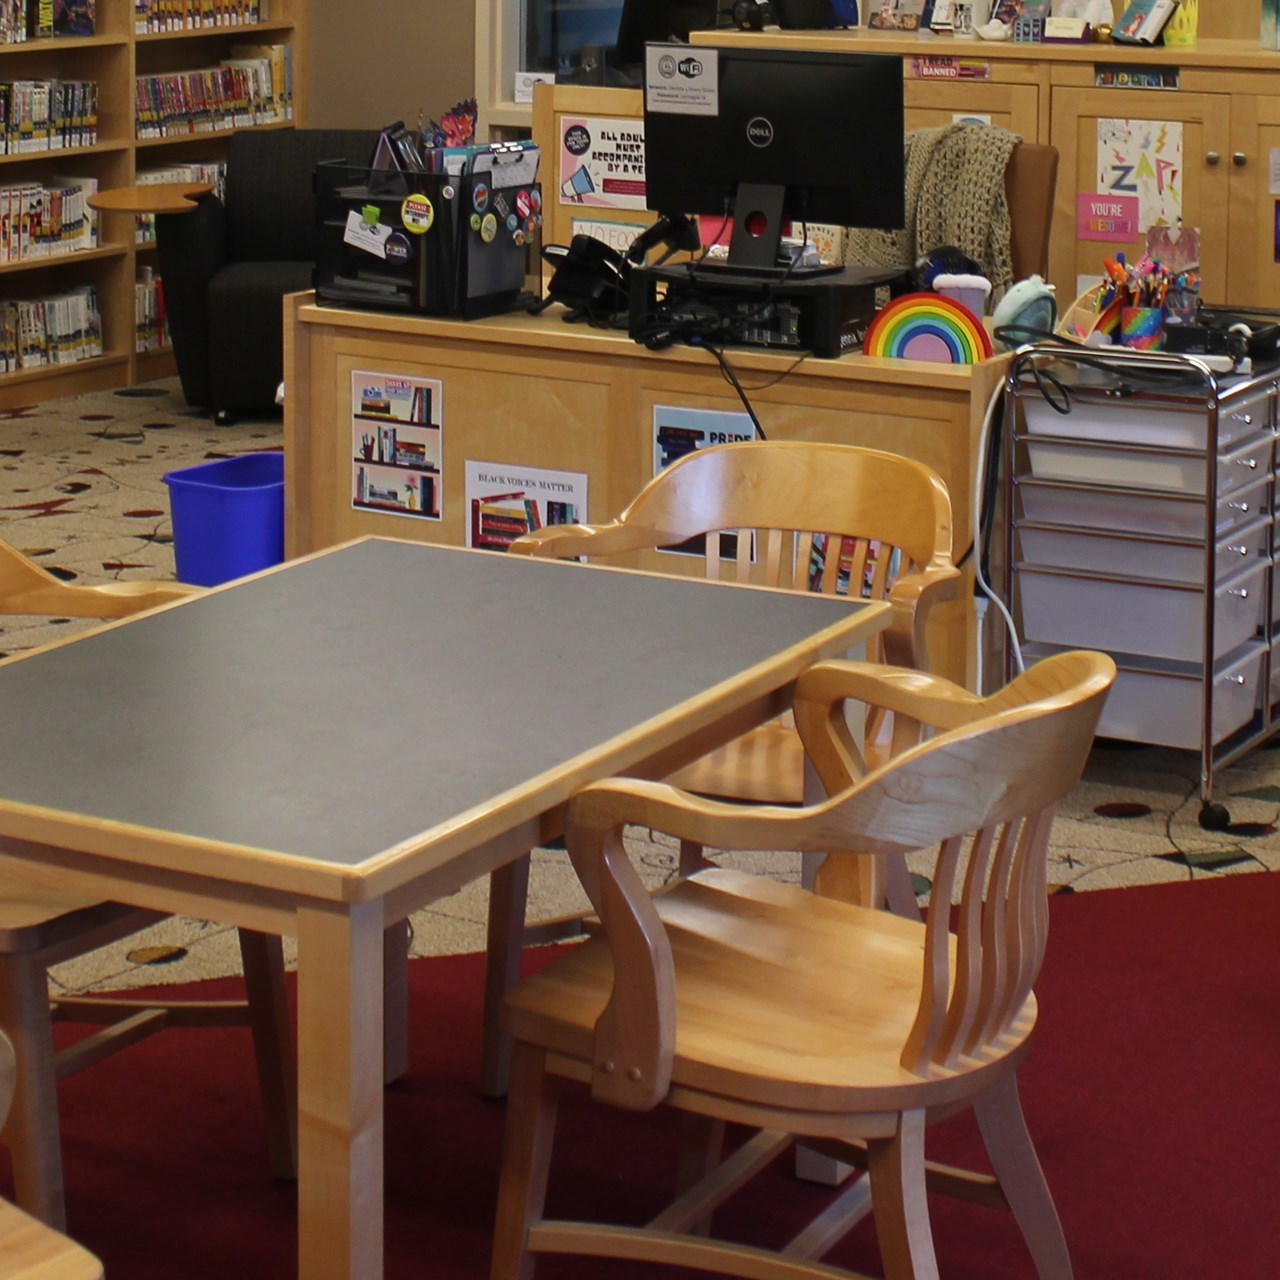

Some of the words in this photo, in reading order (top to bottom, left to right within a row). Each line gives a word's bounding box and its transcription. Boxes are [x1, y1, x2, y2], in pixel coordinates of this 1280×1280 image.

[929, 57, 954, 67] READ
[922, 67, 957, 77] BANNED
[601, 131, 618, 142] ALL
[749, 127, 770, 137] DELL
[616, 143, 641, 153] MUST
[607, 163, 621, 172] BY
[1109, 152, 1178, 194] ZAP!
[408, 202, 428, 212] PLEASE
[1090, 202, 1124, 218] YOU'RE
[478, 473, 506, 485] BLACK
[507, 476, 537, 489] VOICES
[538, 479, 575, 493] MATTER
